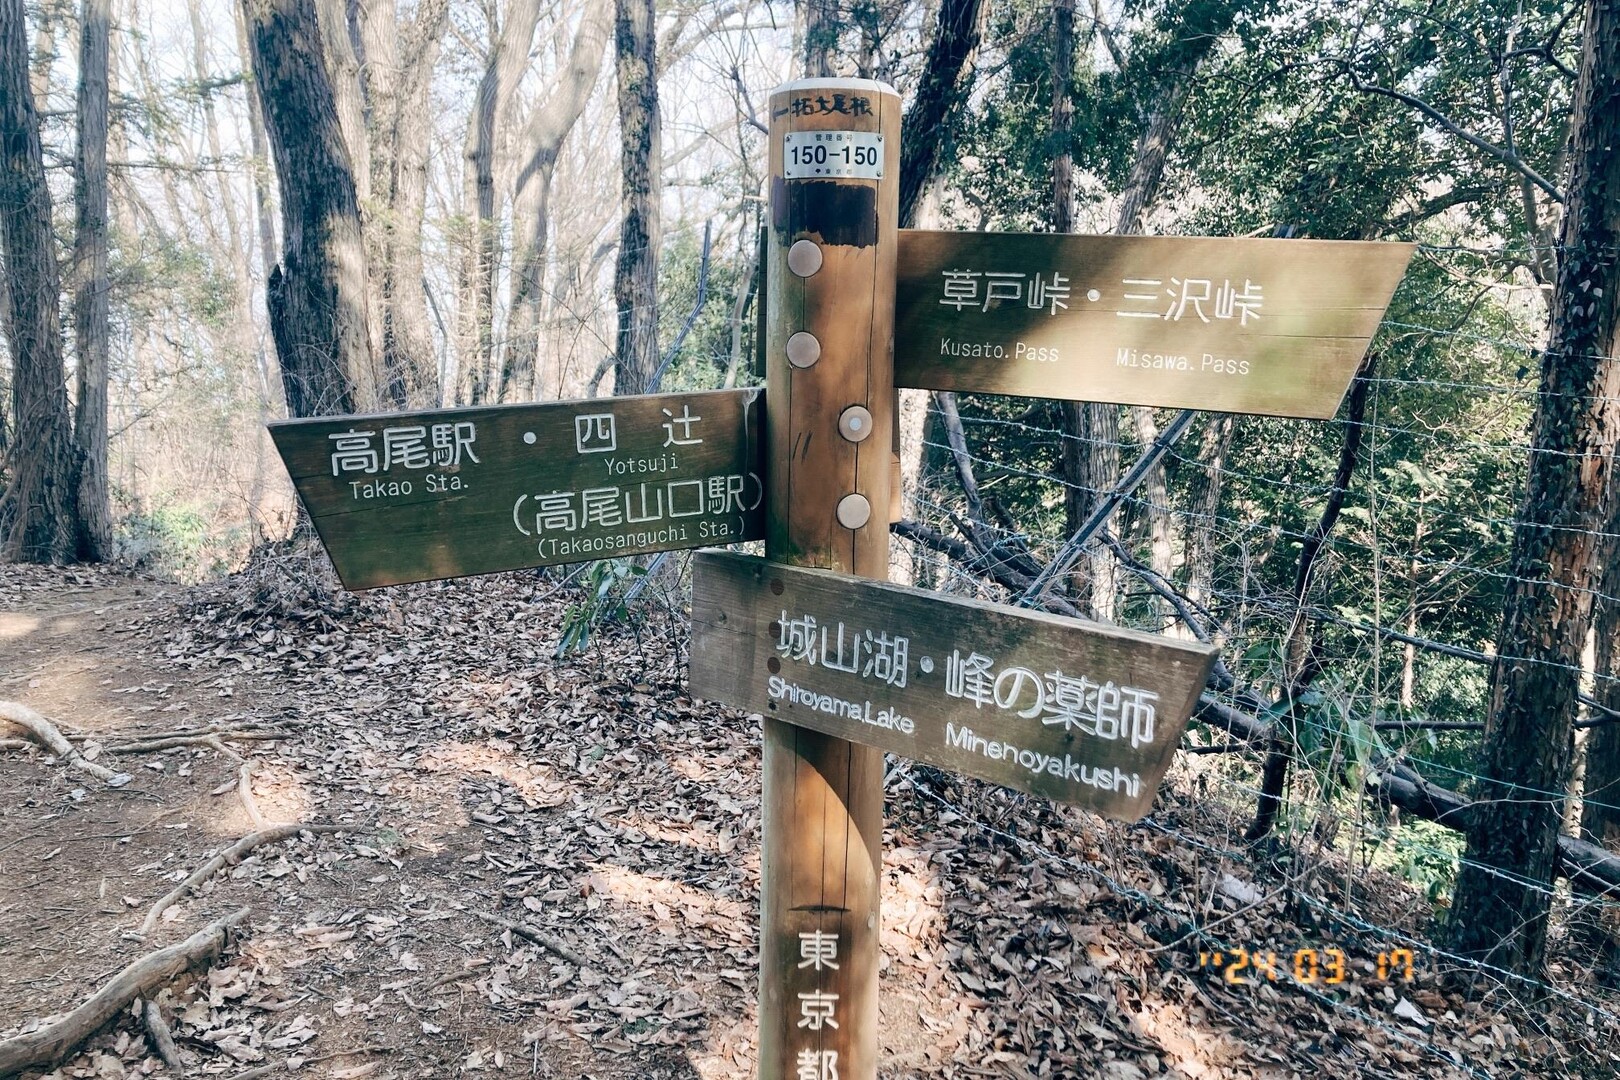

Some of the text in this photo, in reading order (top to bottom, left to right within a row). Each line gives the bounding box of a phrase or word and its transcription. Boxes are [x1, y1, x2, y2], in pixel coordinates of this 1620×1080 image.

[791, 145, 878, 166] 150-150
[604, 453, 679, 476] Yotsuji
[348, 473, 469, 500] Takao Sta.
[538, 515, 745, 559] (Takaosanguchi Sta.)
[945, 722, 1140, 798] Minenoyakushi
[797, 929, 840, 1080] 東京都
